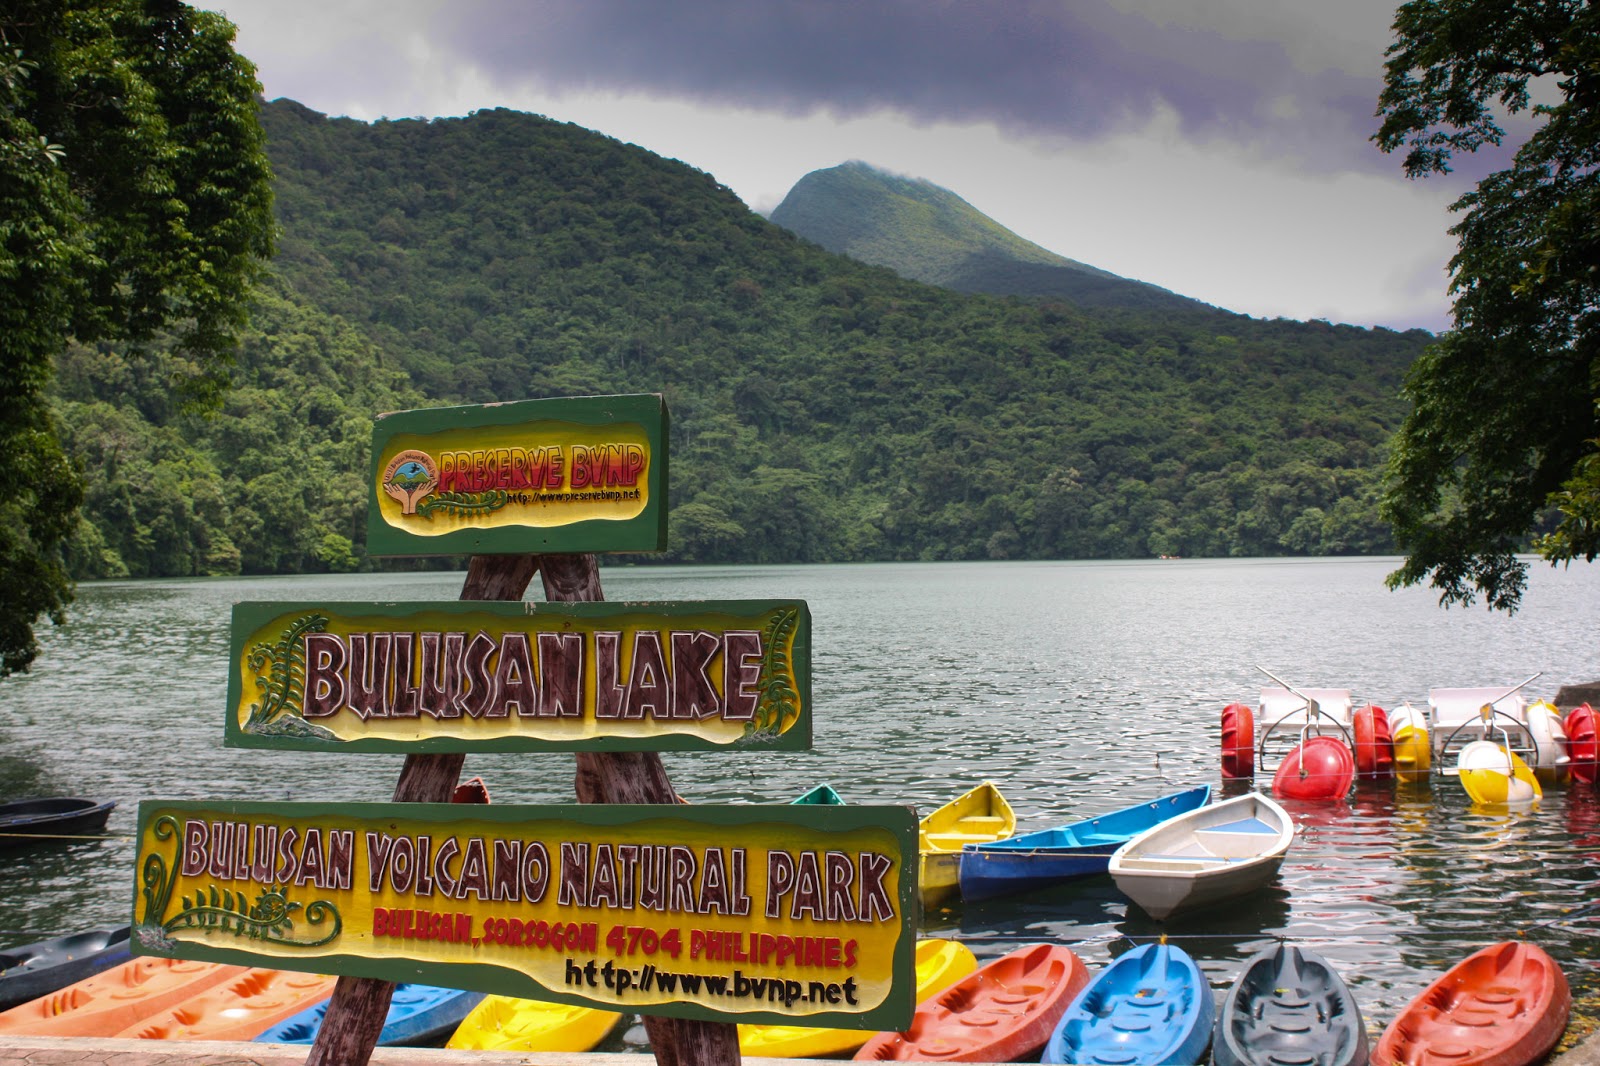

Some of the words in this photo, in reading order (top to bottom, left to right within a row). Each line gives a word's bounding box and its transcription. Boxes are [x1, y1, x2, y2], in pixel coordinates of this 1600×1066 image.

[438, 445, 564, 493] PRESERVE
[570, 442, 645, 488] BVNP
[506, 488, 640, 505] http://www.preservebvnp.net
[302, 630, 586, 723] BULUSAN
[593, 629, 765, 722] LAKE
[181, 818, 357, 891] BULUSAN
[365, 830, 551, 903] VOLCANO
[557, 841, 751, 916] NATURAL
[764, 849, 898, 923] PARK
[372, 907, 480, 949] BULUSAN,
[482, 916, 598, 952] SORSOGON
[606, 924, 683, 958] 4704
[690, 929, 859, 969] PHILIPPINES
[565, 958, 860, 1007] http://www.bvnp.net
